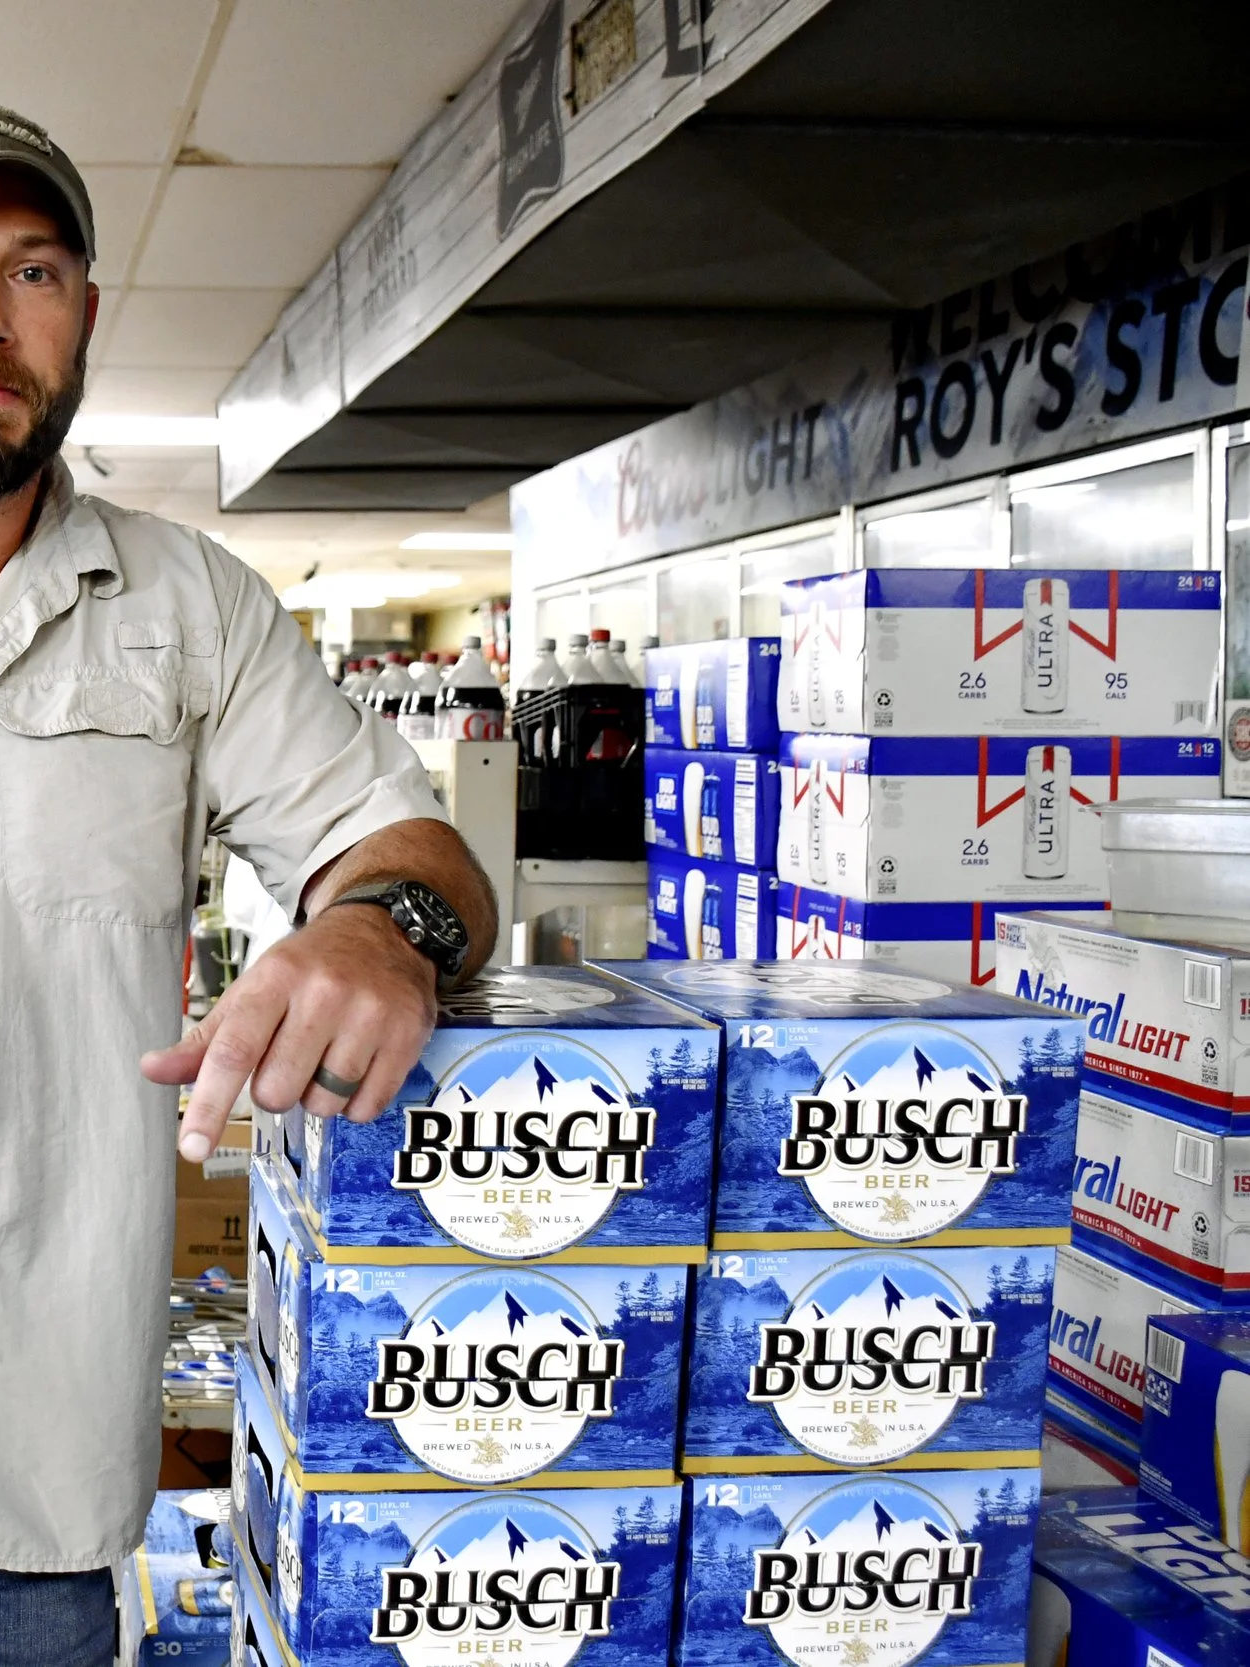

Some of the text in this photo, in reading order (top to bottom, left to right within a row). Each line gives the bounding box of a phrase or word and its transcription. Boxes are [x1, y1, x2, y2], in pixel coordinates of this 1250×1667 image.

[890, 322, 1078, 472] ROY'S
[715, 399, 827, 506] LIGHT
[1178, 576, 1215, 588] 24 12
[759, 643, 779, 657] 24
[1037, 613, 1054, 688] ULTRA
[959, 672, 1128, 690] 2.6 95
[958, 691, 1127, 700] CARBS CALS
[1178, 742, 1215, 754] 24 12
[1038, 780, 1055, 853] ULTRA
[962, 838, 989, 856] 2.6
[961, 858, 990, 866] CARBS
[1015, 969, 1126, 1044] Natural
[739, 1024, 775, 1048] 12
[1117, 1019, 1191, 1063] LIGHT
[1084, 1056, 1107, 1069] MERICA
[1108, 1063, 1127, 1076] SINCE
[781, 1097, 1026, 1173] BUSCH
[394, 1107, 654, 1187] BUSCH
[865, 1174, 930, 1189] BEER
[483, 1189, 552, 1204] BEER
[832, 1200, 879, 1209] BREWED
[1115, 1182, 1181, 1232] LIGHT
[450, 1215, 499, 1224] BREWED
[538, 1215, 550, 1224] IN
[1075, 1213, 1105, 1229] AMERICA
[709, 1255, 744, 1278] 12
[323, 1269, 360, 1292] 12
[750, 1324, 993, 1397] BUSCH
[1094, 1342, 1146, 1392] LIGH
[369, 1342, 623, 1414] BUSCH
[1061, 1365, 1086, 1386] AMERICA
[833, 1399, 897, 1414] BEER
[455, 1417, 523, 1432] BEER
[801, 1425, 848, 1433] BREWED
[423, 1443, 471, 1451] BREWED
[510, 1442, 521, 1450] IN
[705, 1483, 740, 1507] 12
[329, 1501, 366, 1524] 12
[748, 1546, 981, 1621] BUSCH
[375, 1566, 617, 1639] BUSCH
[826, 1618, 889, 1634] BEER
[154, 1641, 182, 1657] 30
[457, 1639, 523, 1654] BEER
[795, 1644, 840, 1653] BREWED
